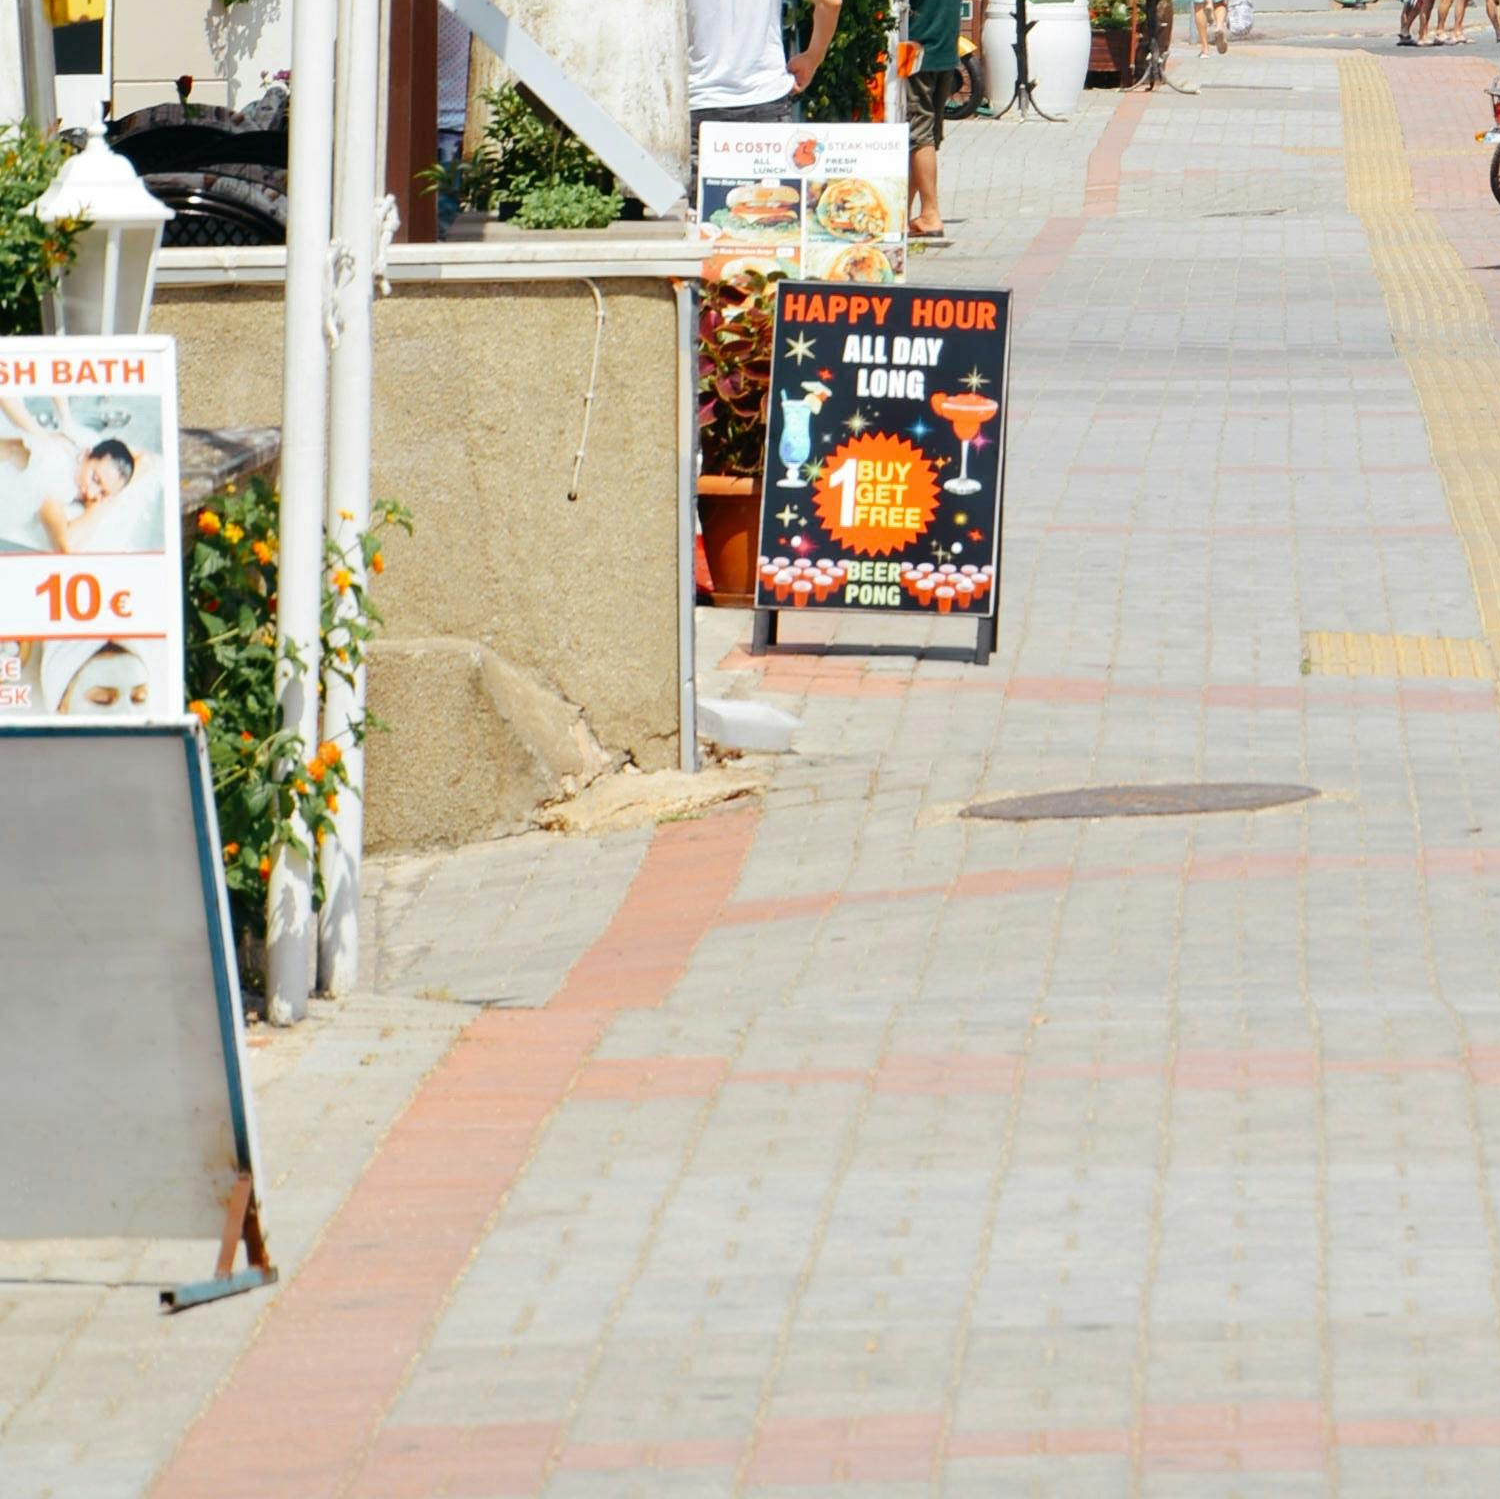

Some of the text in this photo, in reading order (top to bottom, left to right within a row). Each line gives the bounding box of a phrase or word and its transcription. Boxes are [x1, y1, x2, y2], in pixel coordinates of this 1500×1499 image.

[713, 140, 900, 153] LA COSTO STEAK HOUSE
[753, 167, 787, 175] LUNCH
[783, 293, 997, 330] HAPPY HOUR
[842, 334, 944, 366] ALL DAY
[52, 358, 145, 385] BATH
[856, 368, 925, 401] LONG
[857, 460, 912, 483] BUY
[828, 458, 857, 528] 1
[855, 484, 908, 506] GET
[853, 506, 922, 529] FREE
[847, 561, 901, 583] BEER
[845, 584, 901, 606] PONG
